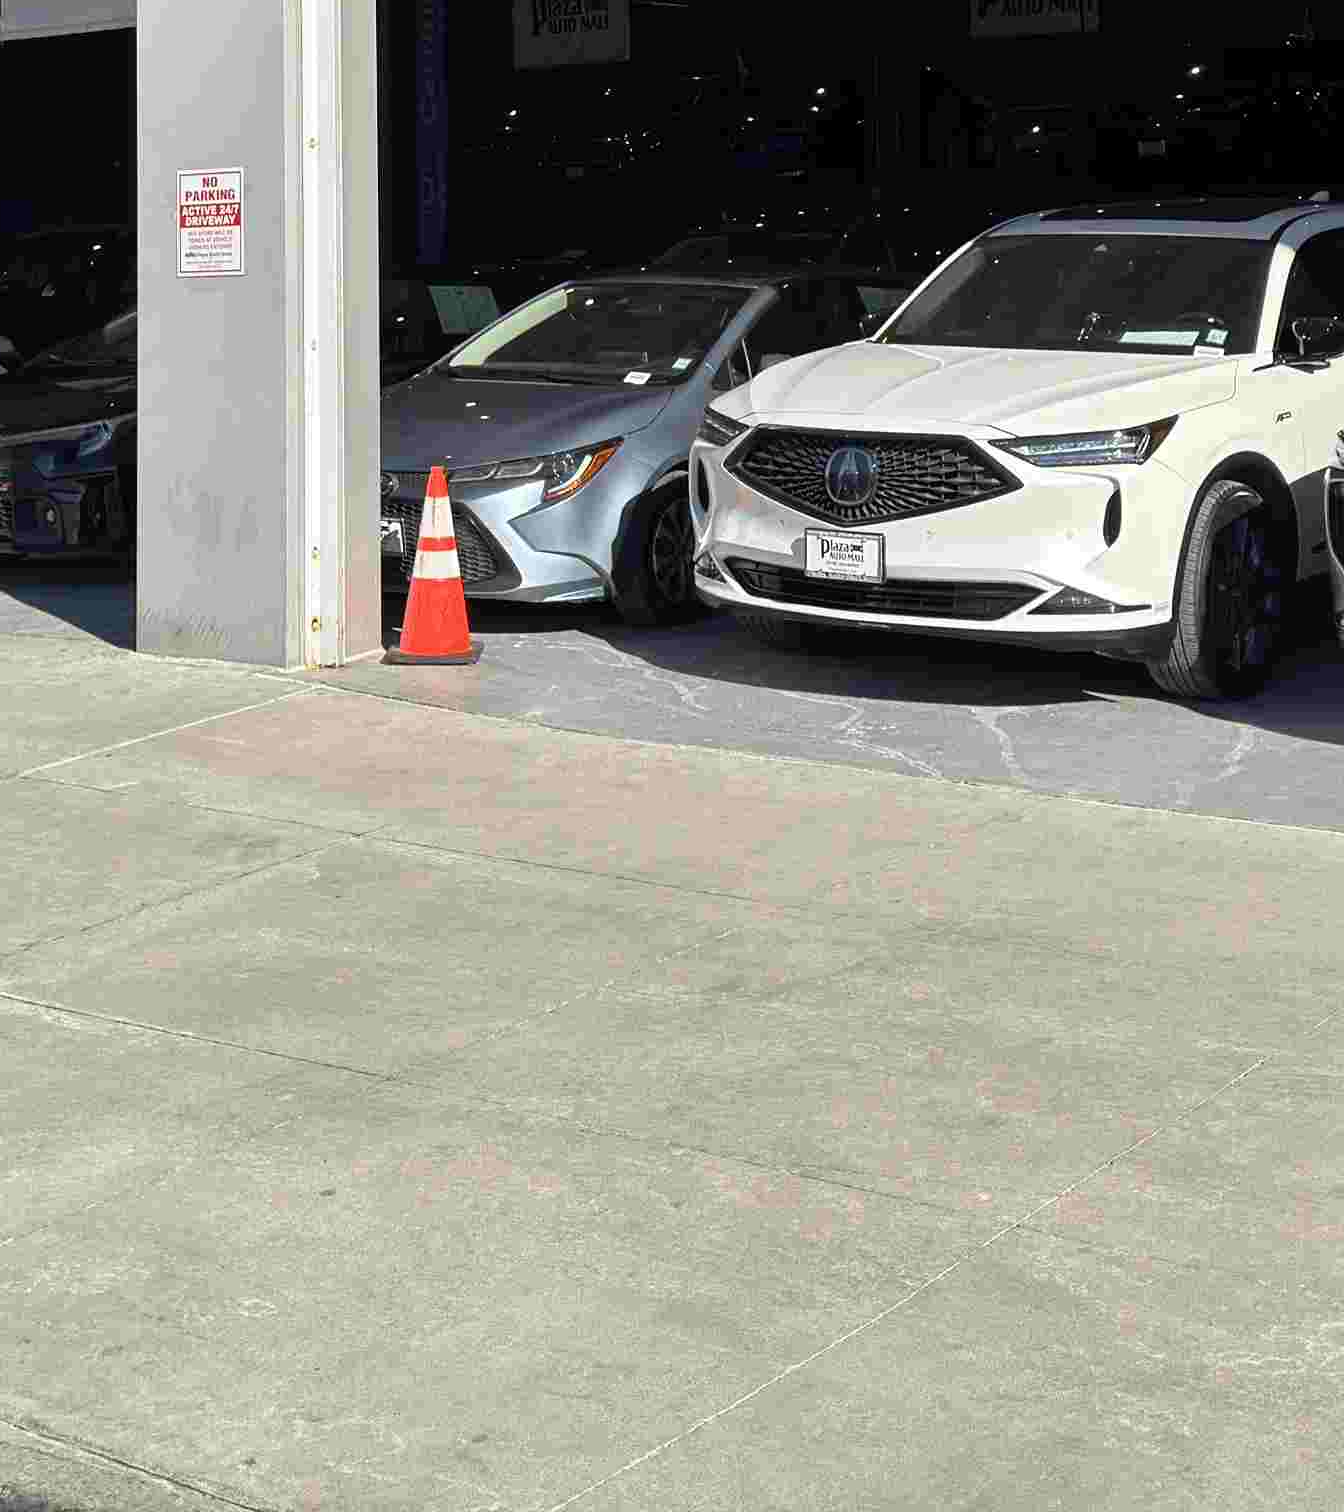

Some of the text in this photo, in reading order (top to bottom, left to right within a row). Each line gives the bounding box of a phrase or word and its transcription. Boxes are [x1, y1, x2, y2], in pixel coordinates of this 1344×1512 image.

[202, 176, 218, 188] NO
[185, 189, 235, 202] PARKING
[182, 205, 217, 217] ACTIVE
[185, 215, 236, 227] DRIVEWAY
[821, 538, 849, 559] Plaza
